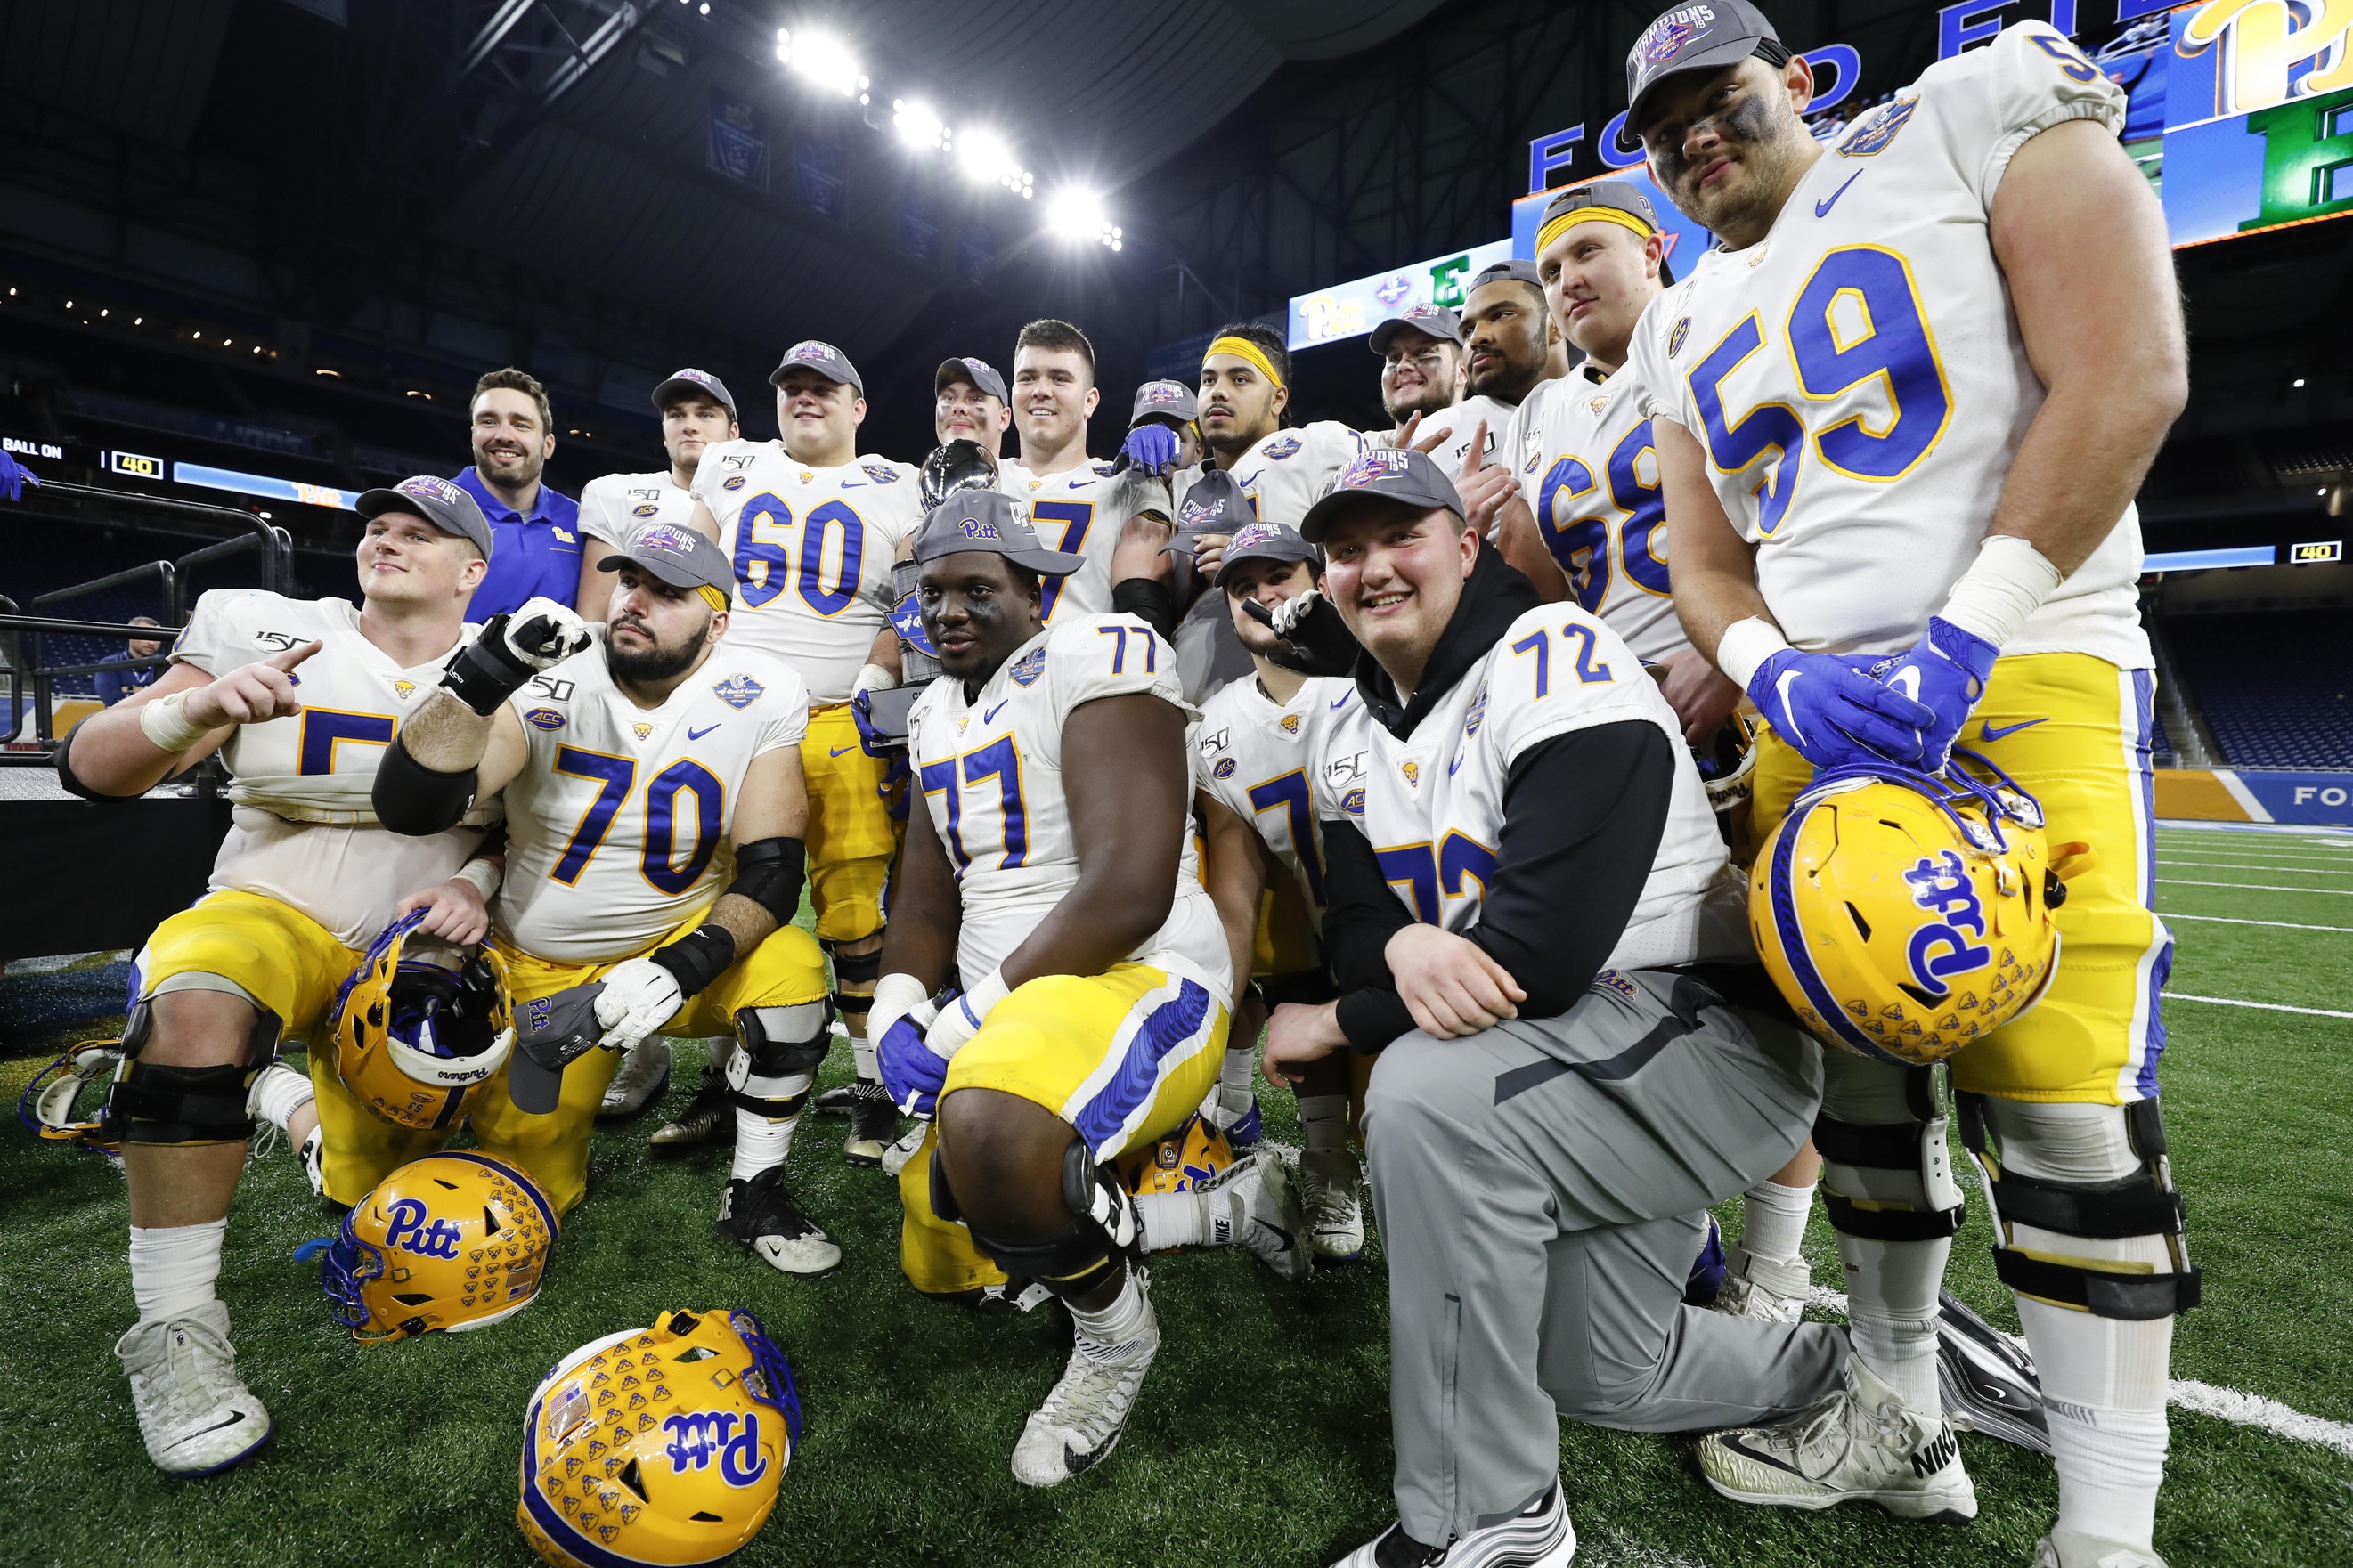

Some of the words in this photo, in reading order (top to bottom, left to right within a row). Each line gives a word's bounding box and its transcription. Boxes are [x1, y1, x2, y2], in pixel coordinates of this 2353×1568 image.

[1694, 20, 1706, 29] 19
[2023, 34, 2105, 85] 5
[1299, 295, 1366, 341] Pitt
[1686, 241, 1956, 540] 59
[3, 437, 39, 456] BALL
[41, 444, 62, 459] ON
[121, 457, 153, 475] 40
[721, 455, 756, 469] 150
[726, 476, 745, 486] ACC
[636, 505, 656, 515] ACC
[1538, 416, 1673, 616] 68
[551, 525, 577, 544] Pitt
[959, 517, 1001, 540] Pitt
[735, 490, 865, 618] 60
[2300, 545, 2332, 559] 40
[1095, 626, 1158, 677] 77
[1509, 622, 1616, 703] 72
[533, 675, 577, 703] 50
[531, 711, 561, 725] ACC
[1217, 759, 1234, 775] ACC
[920, 730, 1030, 883] 77
[1345, 793, 1366, 807] AC
[2293, 786, 2353, 807] FO
[548, 742, 726, 898] 70
[1901, 849, 1993, 996] Pitt
[527, 995, 553, 1033] Pitt
[437, 1066, 488, 1083] Panthers
[408, 1102, 424, 1113] 53
[385, 1198, 463, 1262] Pitt
[1215, 1218, 1230, 1243] NIKE
[660, 1409, 769, 1488] Pitt
[1910, 1419, 1957, 1479] NIK
